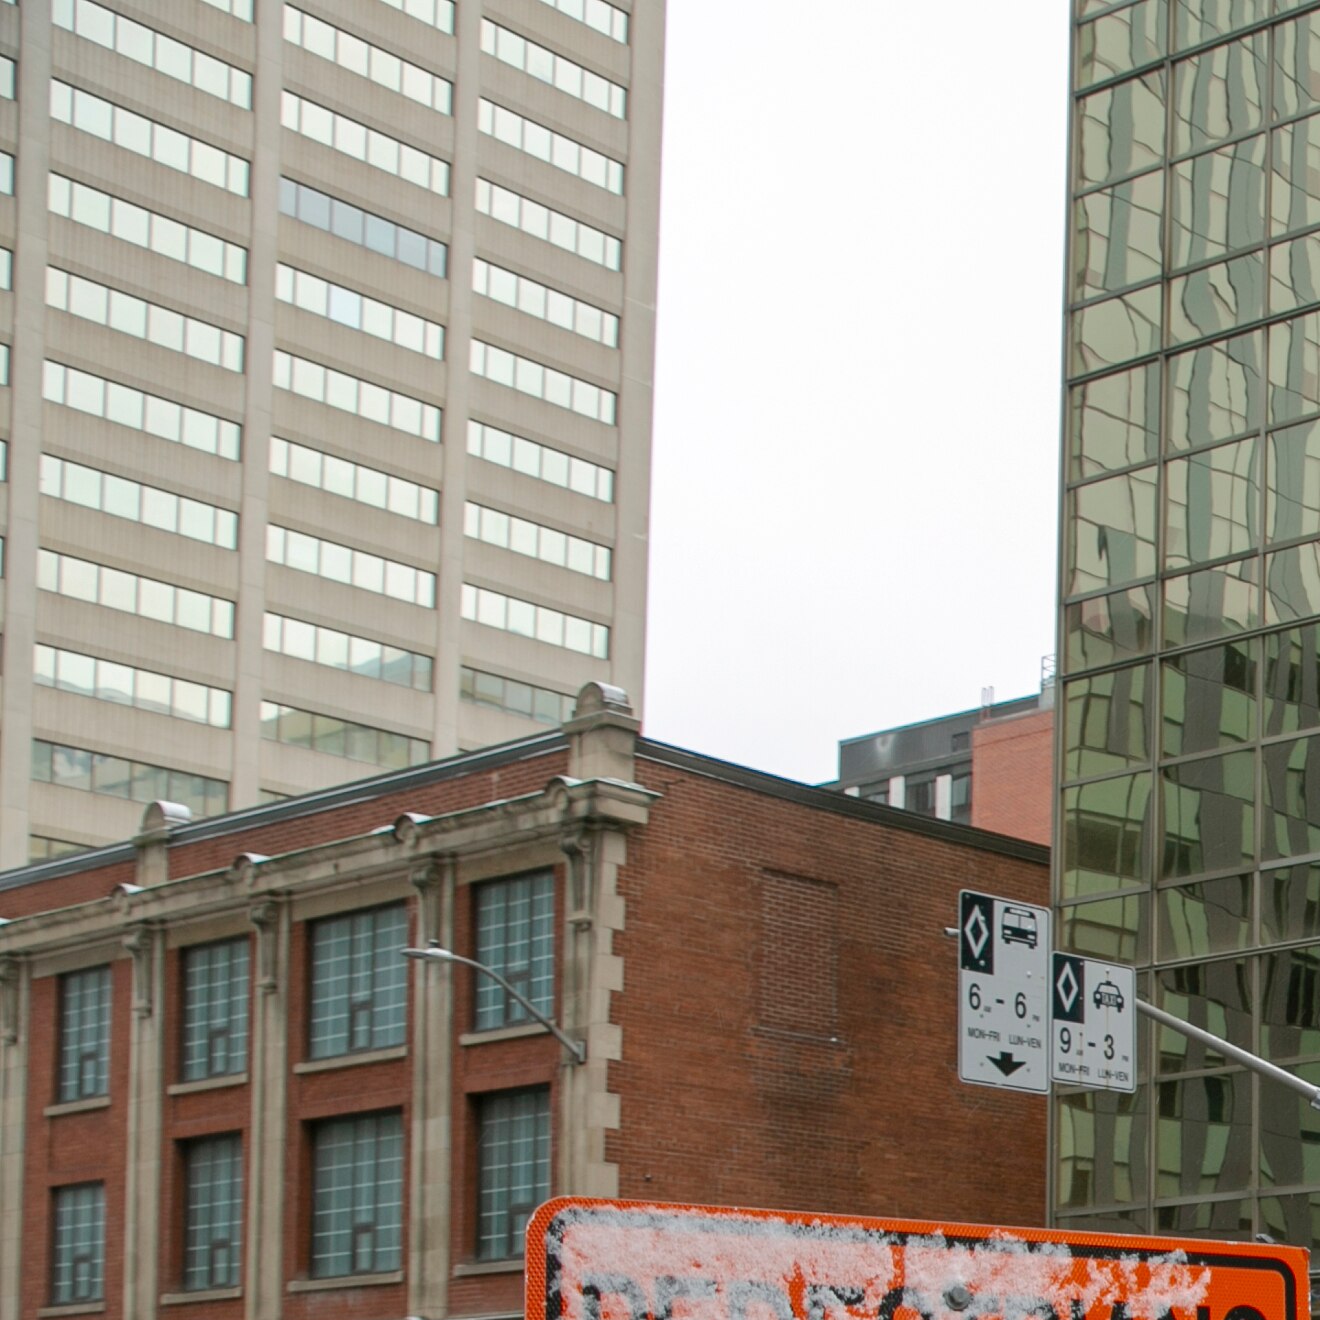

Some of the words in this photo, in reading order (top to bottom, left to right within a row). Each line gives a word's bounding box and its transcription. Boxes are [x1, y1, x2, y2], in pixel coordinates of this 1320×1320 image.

[968, 982, 982, 1011] 6
[1014, 992, 1027, 1019] 6
[967, 1026, 1000, 1042] MON-FRI
[1008, 1033, 1042, 1049] LUN-VEN
[1059, 1027, 1072, 1054] 9
[1103, 1033, 1115, 1060] 3
[1058, 1061, 1090, 1077] MON-FRI
[1097, 1068, 1129, 1083] LUN-VEN
